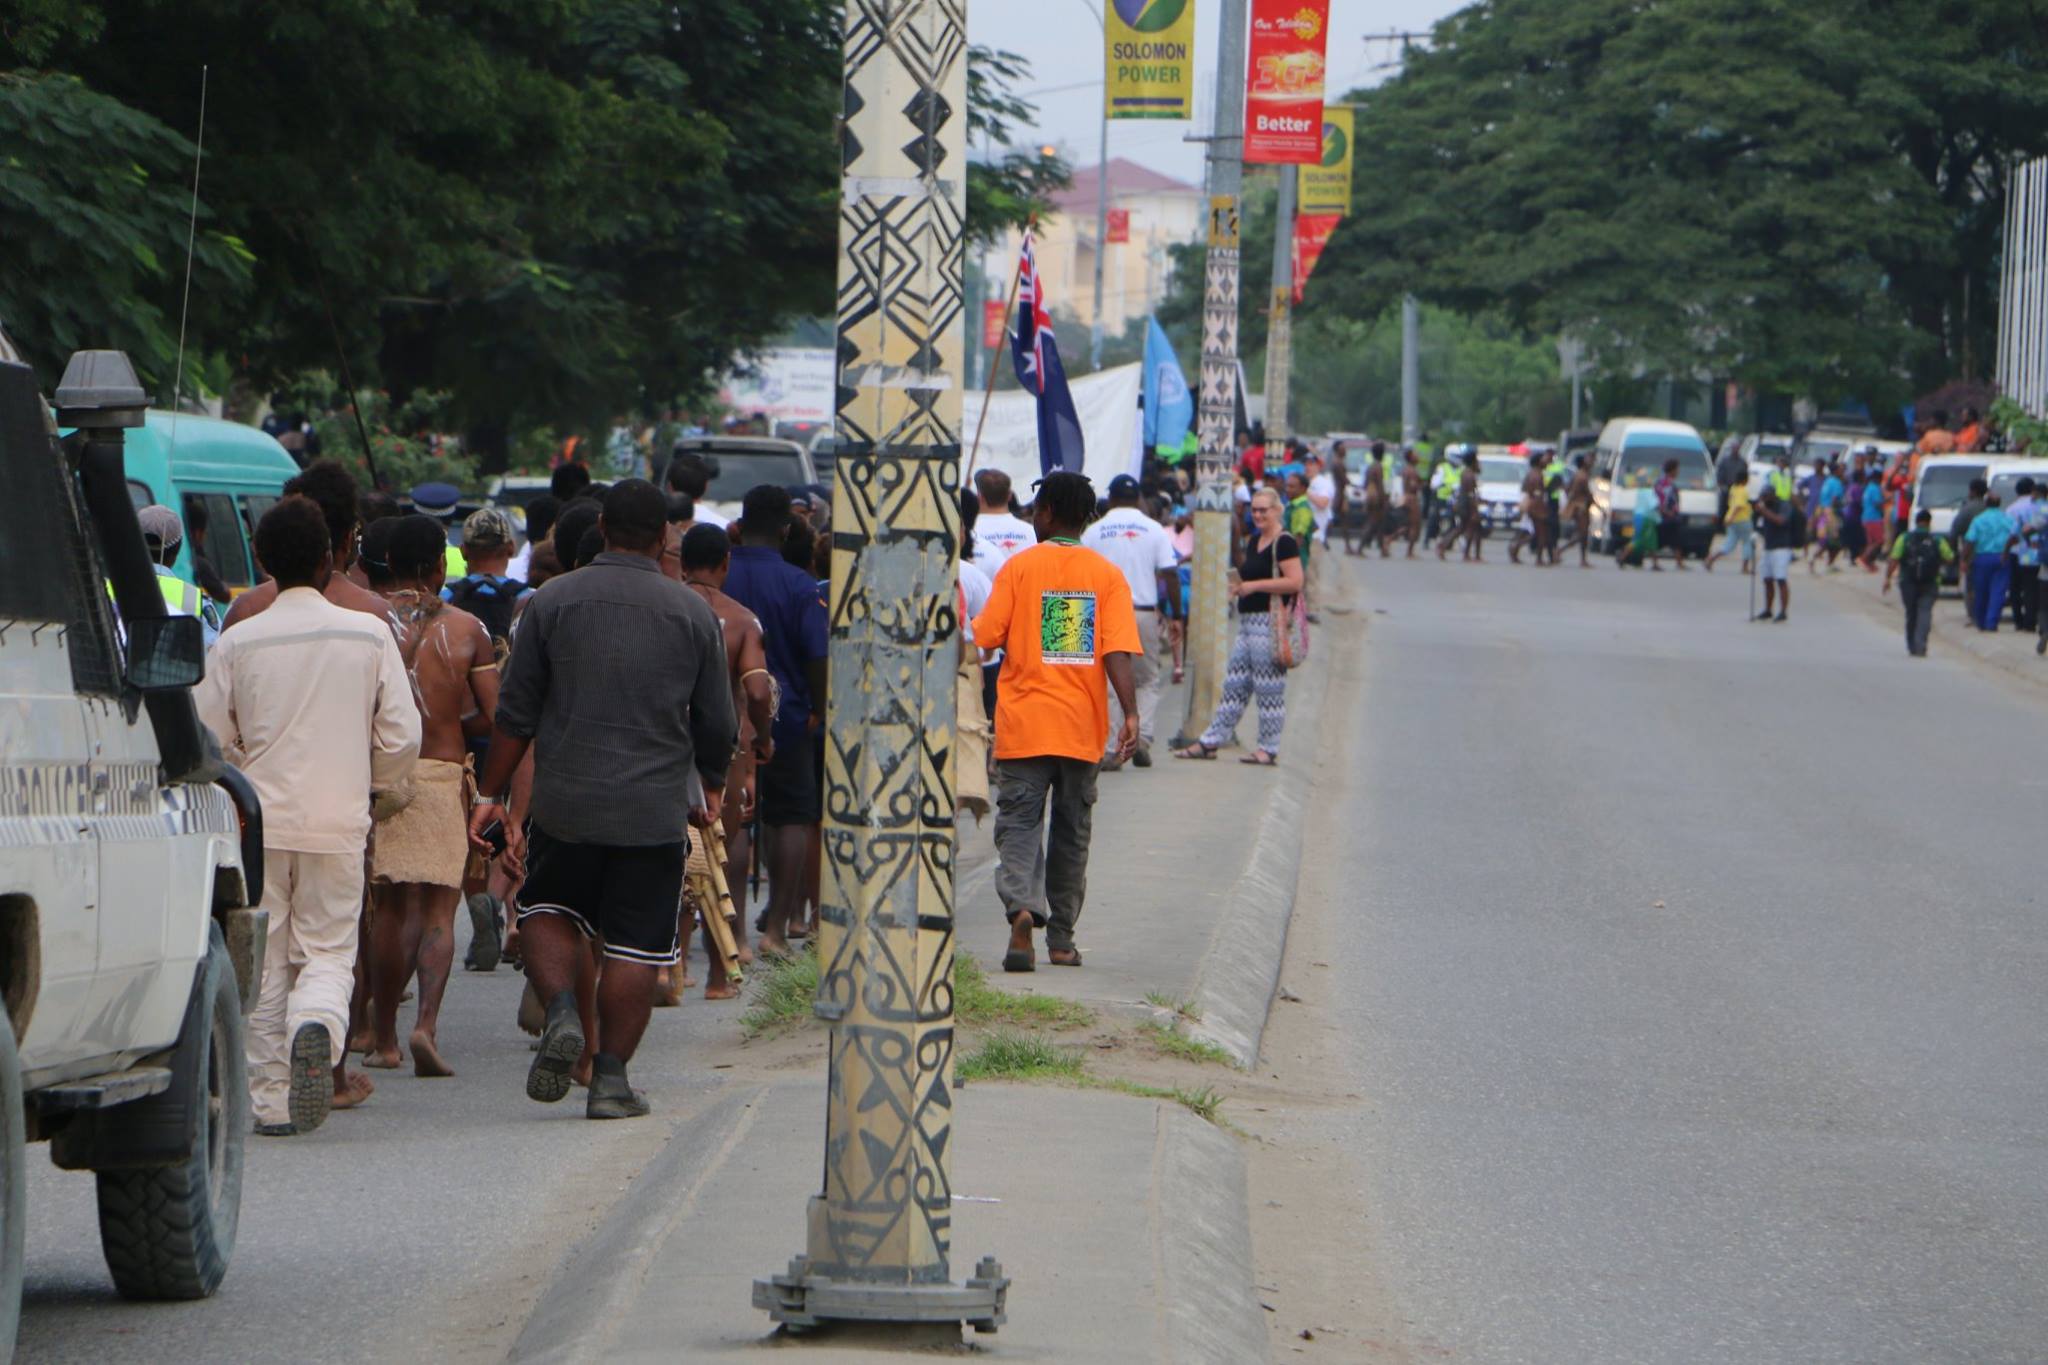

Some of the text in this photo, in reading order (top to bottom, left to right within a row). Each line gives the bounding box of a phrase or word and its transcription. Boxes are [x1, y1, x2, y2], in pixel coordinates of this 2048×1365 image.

[1113, 42, 1186, 60] SOLOMON
[1118, 65, 1181, 83] POWER
[1256, 115, 1312, 133] Better
